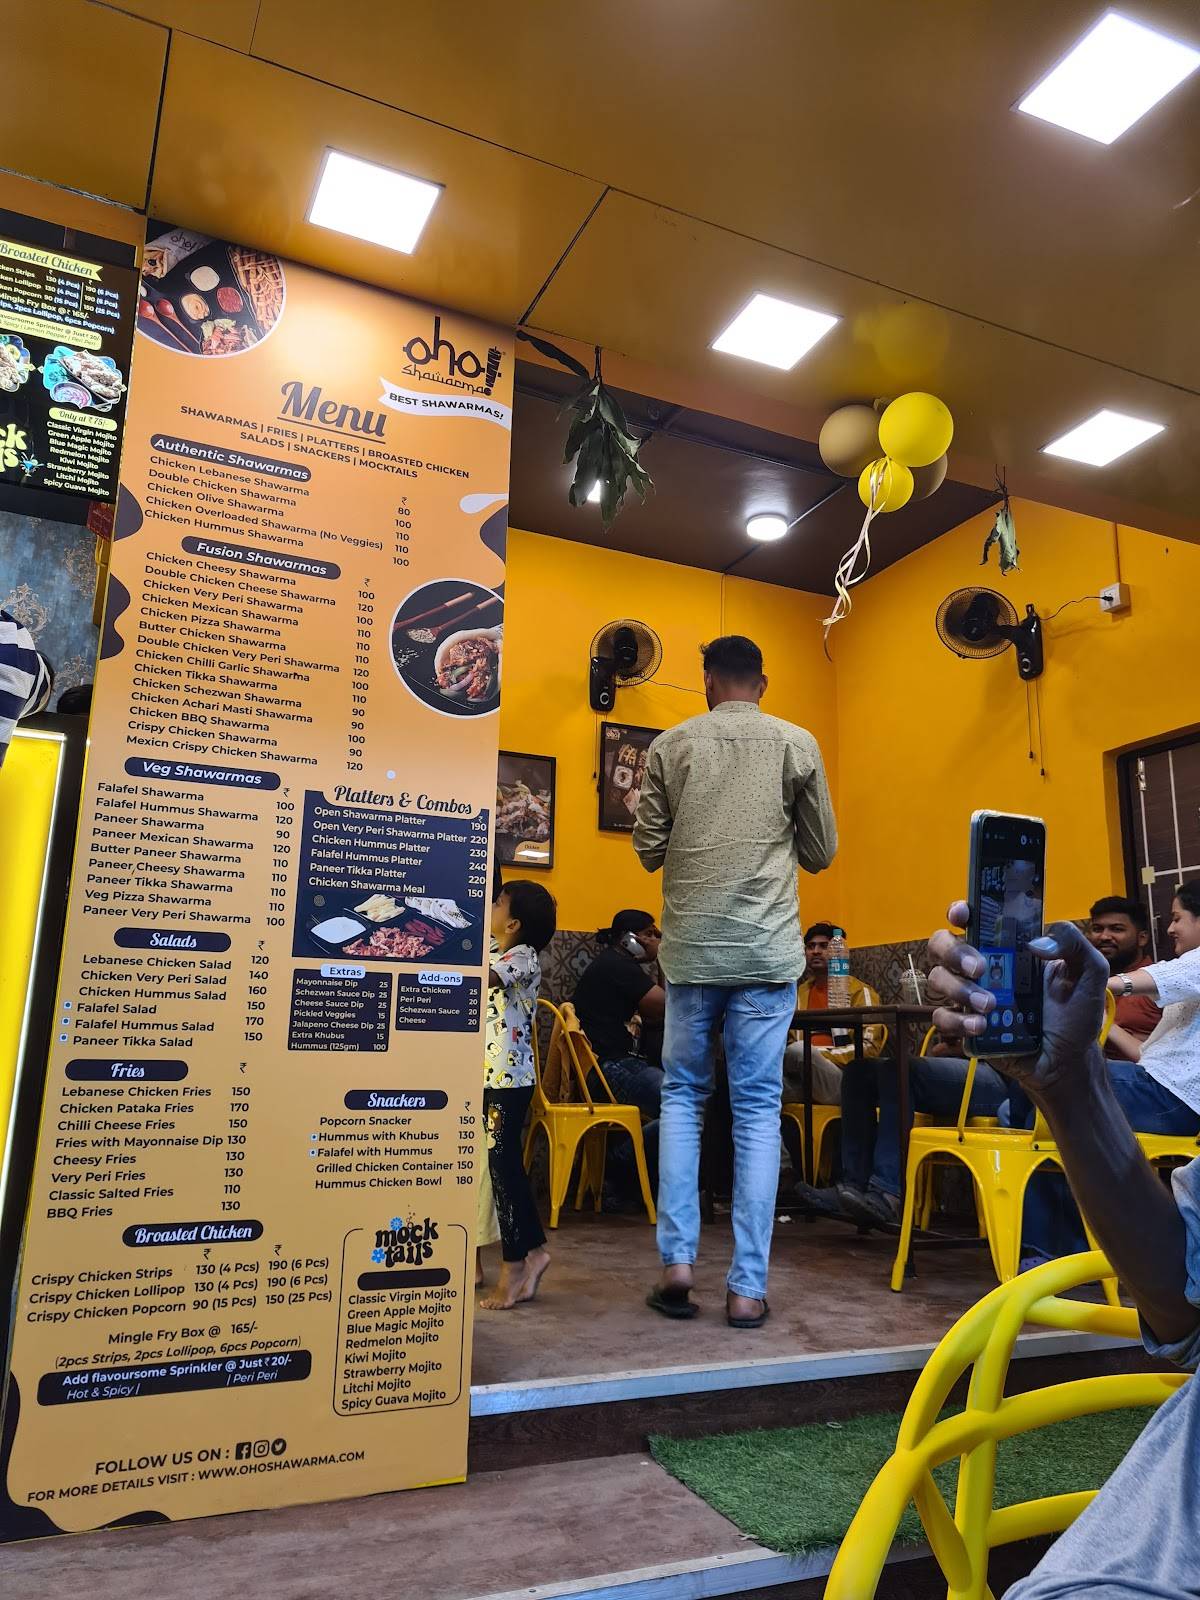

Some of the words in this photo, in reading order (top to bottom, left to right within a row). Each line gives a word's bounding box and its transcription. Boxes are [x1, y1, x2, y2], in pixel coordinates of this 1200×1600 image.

[0, 243, 48, 264] Broasted
[51, 256, 92, 276] Chicken
[59, 410, 76, 421] Only
[281, 380, 388, 437] Menu
[388, 392, 418, 406] BEST
[422, 400, 504, 420] SHAWARMAS!
[47, 422, 72, 432] Classic
[73, 426, 94, 436] Virgin
[96, 430, 118, 441] Mojito
[180, 405, 258, 430] SHAWARMAS
[267, 425, 297, 439] FRIES
[306, 435, 360, 454] PLATTERS
[368, 449, 423, 468] BROASTED
[425, 462, 469, 479] CHICKEN
[154, 438, 225, 461] Authentic
[227, 454, 308, 479] Shawarmas
[240, 431, 284, 448] SALADS
[293, 444, 351, 463] SNACKERS
[359, 458, 418, 478] MOCKTAILS
[46, 462, 86, 476] Strawberry
[88, 470, 110, 480] Mojito
[44, 478, 62, 488] Spicy
[64, 482, 86, 492] Guava
[88, 486, 110, 496] Mojito
[150, 455, 196, 472] Chicken
[199, 466, 251, 484] Lebanese
[253, 477, 310, 496] Shawarma
[397, 507, 411, 516] 80
[145, 495, 192, 512] Chicken
[195, 505, 258, 525] Overloaded
[261, 518, 317, 536] Shawarma
[320, 530, 338, 540] (No
[340, 534, 383, 551] Veggies)
[395, 544, 409, 554] 110
[196, 542, 243, 559] Fusion
[246, 551, 327, 575] Shawarmas
[145, 565, 186, 580] Double
[189, 573, 235, 588] Chicken
[238, 582, 278, 596] Cheese
[280, 589, 336, 606] Shawarma
[358, 603, 374, 613] 120
[132, 677, 180, 691] Chicken
[183, 684, 241, 700] Schezwan
[244, 692, 302, 708] Shawarma
[352, 708, 365, 717] 90
[126, 735, 169, 748] Mexicn
[172, 740, 209, 754] Crispy
[211, 745, 257, 758] Chicken
[260, 750, 318, 765] Shawarma
[346, 761, 363, 771] 120
[143, 761, 171, 776] Veg
[174, 765, 262, 784] Shawarmas
[96, 797, 137, 809] Falafel
[140, 801, 195, 815] Hummus
[197, 807, 258, 821] Shawarma
[275, 815, 293, 825] 120
[334, 785, 394, 806] Platters
[398, 792, 412, 808] &
[416, 794, 472, 815] Combos
[313, 820, 340, 831] Open
[342, 822, 364, 835] Very
[365, 825, 384, 835] Peri
[385, 827, 435, 840] Shawarma
[436, 832, 467, 842] Platter
[470, 835, 487, 844] 220
[90, 842, 130, 854] Butter
[133, 846, 177, 858] Paneer
[179, 850, 241, 863] Shawarma
[272, 858, 288, 868] 110
[308, 876, 348, 888] Chicken
[350, 880, 401, 892] Shawarma
[403, 884, 425, 894] Meal
[467, 888, 483, 898] 150
[149, 932, 197, 948] Salads
[82, 954, 143, 966] Lebanese
[146, 957, 196, 968] Chicken
[199, 959, 232, 970] Salad
[251, 955, 270, 965] 120
[329, 967, 362, 976] Extras
[296, 978, 343, 986] Mayonnaise
[344, 979, 358, 988] Dip
[420, 973, 461, 983] Add-ons
[421, 986, 451, 994] Chicken
[73, 1035, 119, 1046] Paneer
[122, 1036, 156, 1046] Tikka
[159, 1037, 193, 1047] Salad
[244, 1032, 263, 1041] 150
[329, 1042, 359, 1051] (125gm)
[111, 1062, 145, 1078] Fries
[59, 1102, 113, 1114] Chicken
[117, 1103, 161, 1113] Pataka
[164, 1102, 194, 1113] Fries
[230, 1102, 249, 1112] 170
[367, 1092, 426, 1107] Snackers
[319, 1116, 366, 1128] Popcorn
[368, 1116, 412, 1125] Snacker
[459, 1116, 475, 1125] 150
[55, 1137, 88, 1148] Fries
[91, 1136, 120, 1147] with
[124, 1135, 199, 1149] Mayonnaise
[202, 1135, 223, 1147] Dip
[227, 1135, 246, 1145] 130
[316, 1162, 352, 1173] Grilled
[355, 1161, 399, 1172] Chicken
[402, 1160, 454, 1171] Container
[457, 1160, 474, 1170] 150
[46, 1207, 78, 1219] BBQ
[81, 1205, 113, 1217] Fries
[221, 1200, 240, 1211] 130
[134, 1226, 198, 1243] Broasted
[200, 1224, 252, 1240] Chicken
[375, 1218, 438, 1248] mock
[384, 1242, 433, 1268] tails
[29, 1291, 72, 1304] Crispy
[75, 1288, 130, 1301] Chicken
[134, 1284, 185, 1297] Lollipop
[194, 1281, 214, 1292] 130
[217, 1280, 230, 1293] (4
[232, 1278, 258, 1291] Pcs)
[267, 1276, 286, 1288] 190
[289, 1276, 301, 1288] (6
[304, 1273, 328, 1286] Pcs)
[348, 1292, 386, 1305] Classic
[389, 1290, 421, 1303] Virgin
[424, 1288, 457, 1301] Mojito
[108, 1330, 153, 1345] Mingle
[157, 1329, 178, 1342] Fry
[180, 1328, 205, 1338] Box
[208, 1325, 221, 1338] @
[231, 1320, 258, 1334] 165/-
[62, 1373, 89, 1386] Add
[91, 1368, 167, 1383] flavoursome
[169, 1362, 222, 1377] Sprinkler
[225, 1360, 237, 1372] @
[238, 1358, 262, 1369] Just
[271, 1353, 292, 1366] 20/-
[343, 1365, 406, 1379] Strawberry
[408, 1360, 442, 1374] Mojito
[95, 1454, 168, 1475] FOLLOW
[172, 1451, 193, 1465] US
[197, 1448, 221, 1462] ON
[27, 1490, 55, 1503] FOR
[58, 1484, 98, 1499] MORE
[101, 1476, 154, 1493] DETAILS
[157, 1472, 189, 1485] VISIT
[198, 1450, 364, 1480] WWW.OHOSHAWARMA.COM
